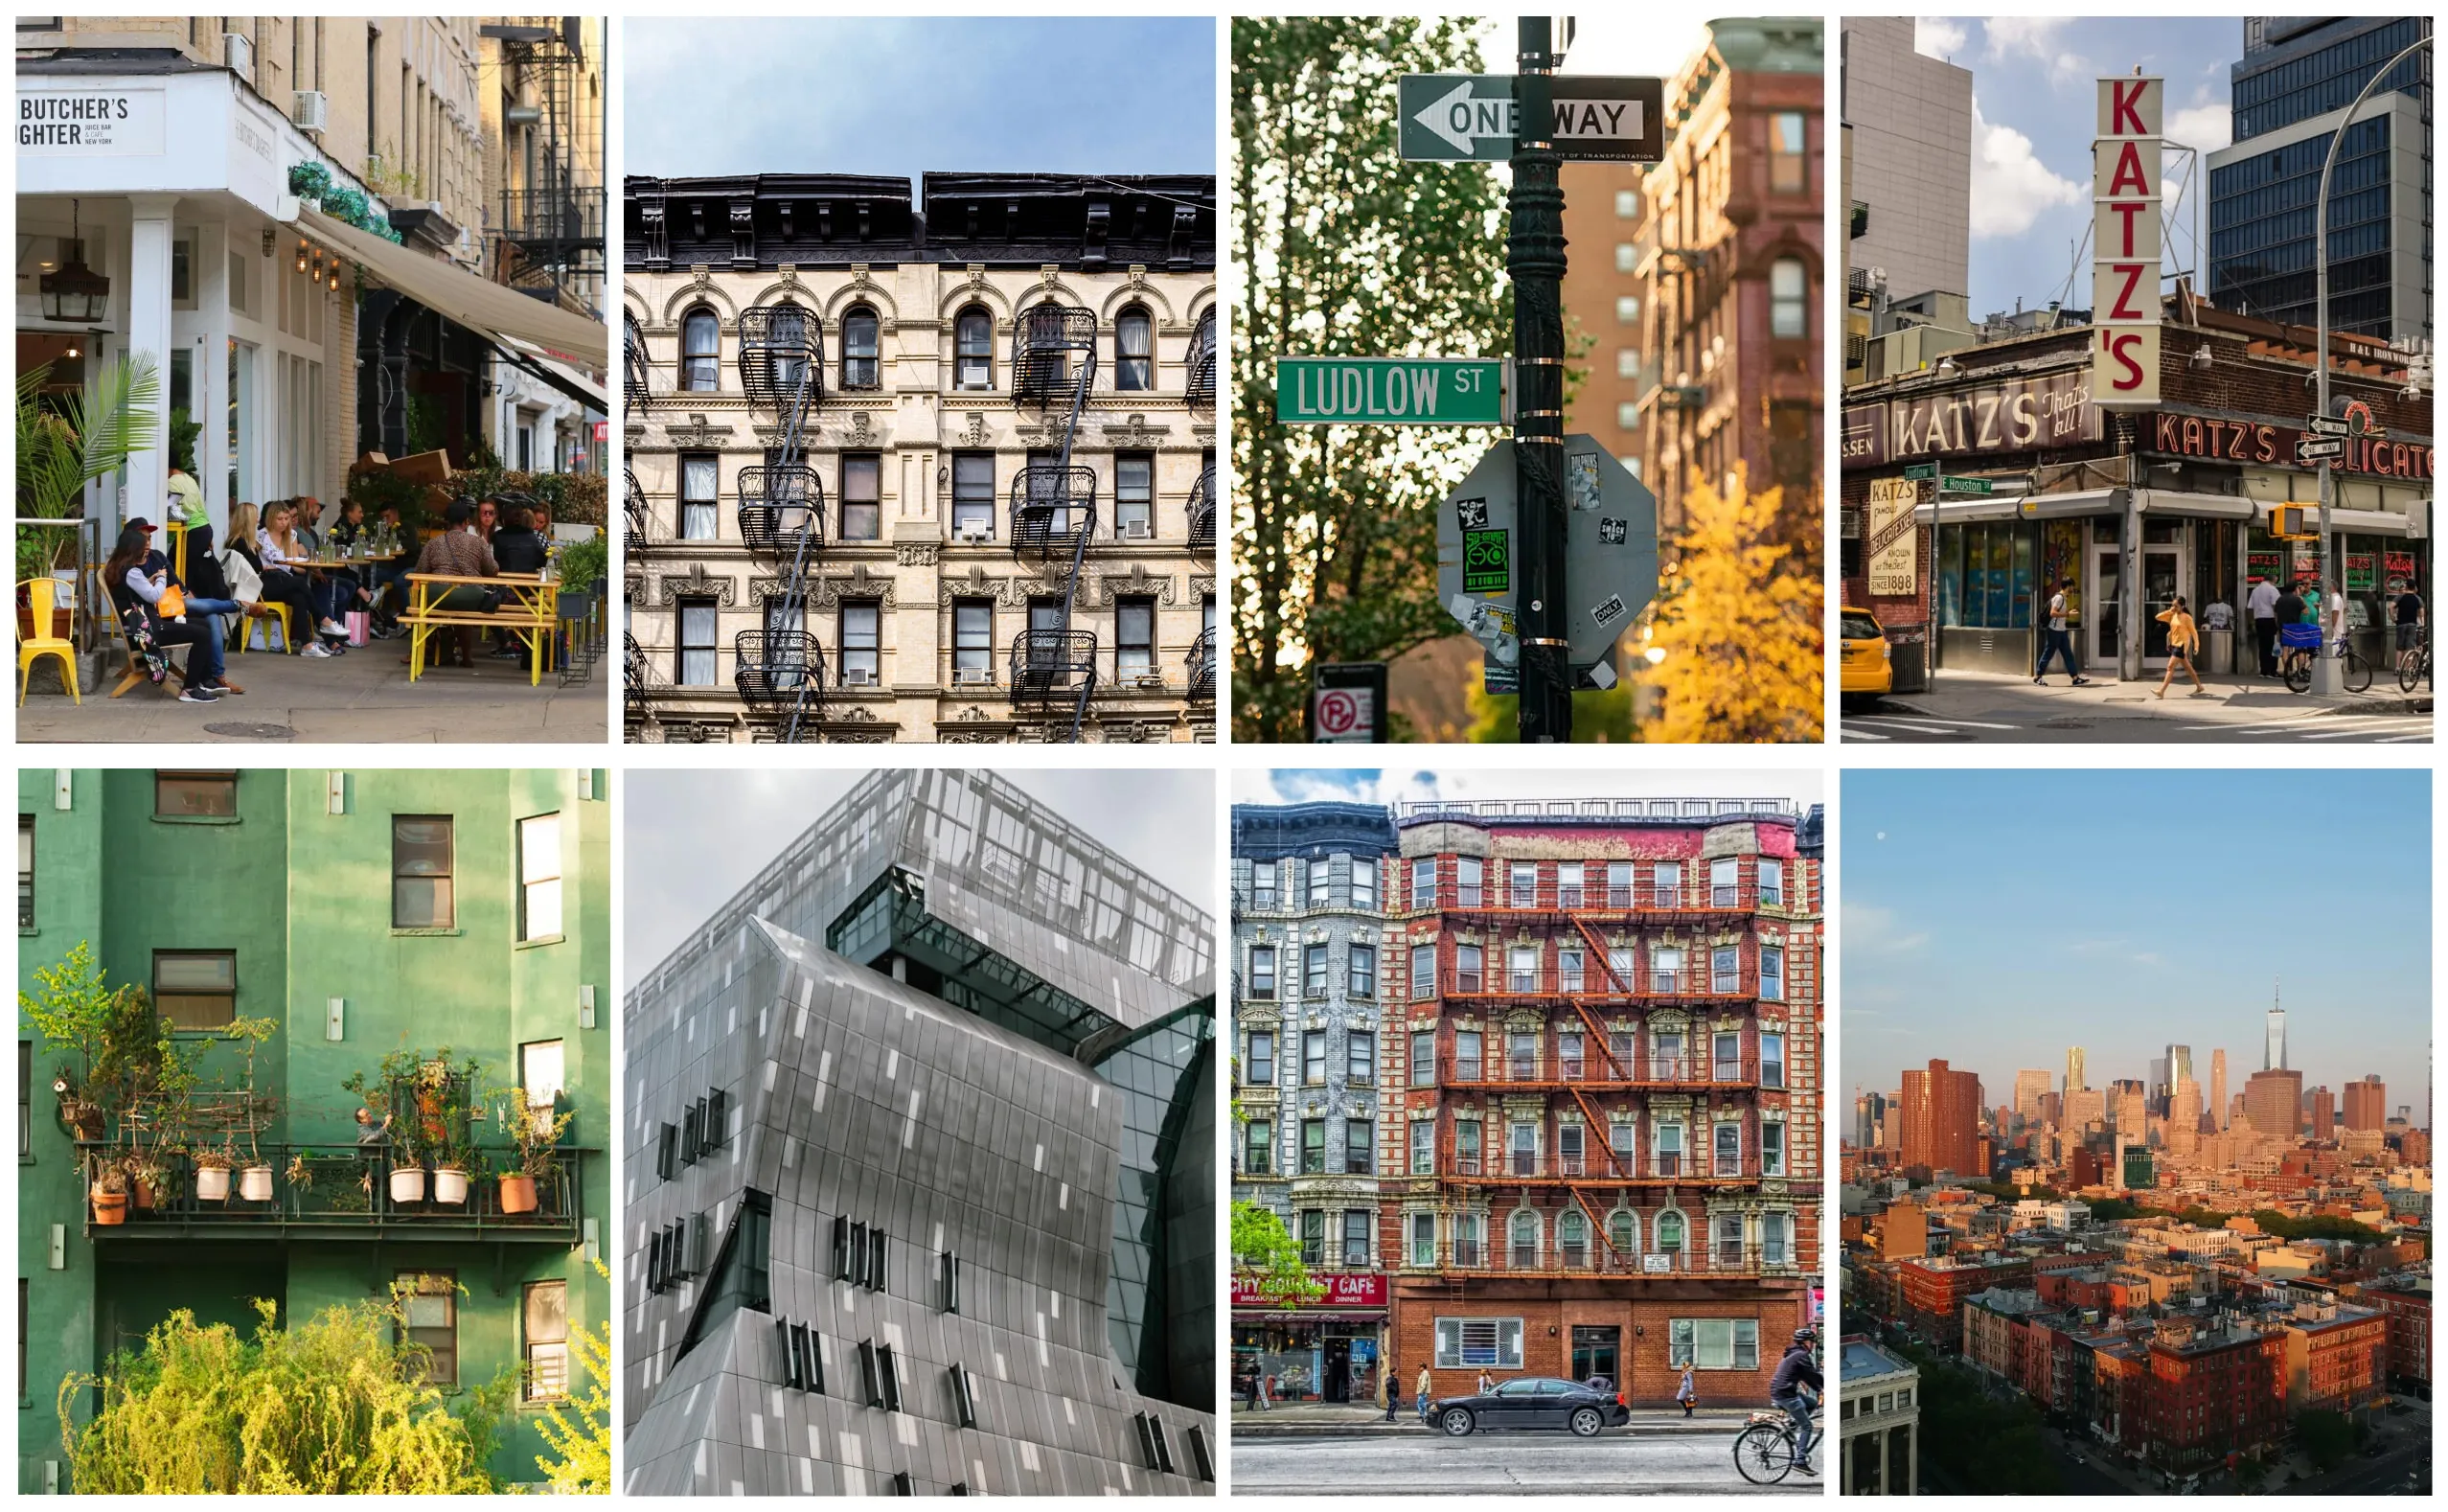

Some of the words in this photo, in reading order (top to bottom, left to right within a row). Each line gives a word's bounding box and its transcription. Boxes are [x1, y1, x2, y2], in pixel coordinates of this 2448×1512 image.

[21, 99, 128, 120] BUTCHER'S
[1450, 103, 1520, 133] ONE
[1552, 103, 1626, 135] WAY
[16, 124, 81, 146] GHTER
[2109, 81, 2149, 390] KATZ'S
[1298, 367, 1439, 415] LUDLOW
[1454, 369, 1484, 392] ST
[597, 424, 608, 438] AT
[1897, 392, 2038, 456] KATZ'S
[2315, 422, 2326, 430] ONE
[1842, 437, 1873, 458] SSEN
[2157, 413, 2276, 463] KATZ'S
[1906, 467, 1929, 479] Ludlow
[1942, 478, 1947, 488] E
[1950, 478, 1981, 491] Houston
[1870, 510, 1915, 555] DELICATESSEN
[1871, 582, 1887, 590] SINCE
[1231, 1277, 1261, 1294] CITY
[1339, 1277, 1375, 1294] CAFE
